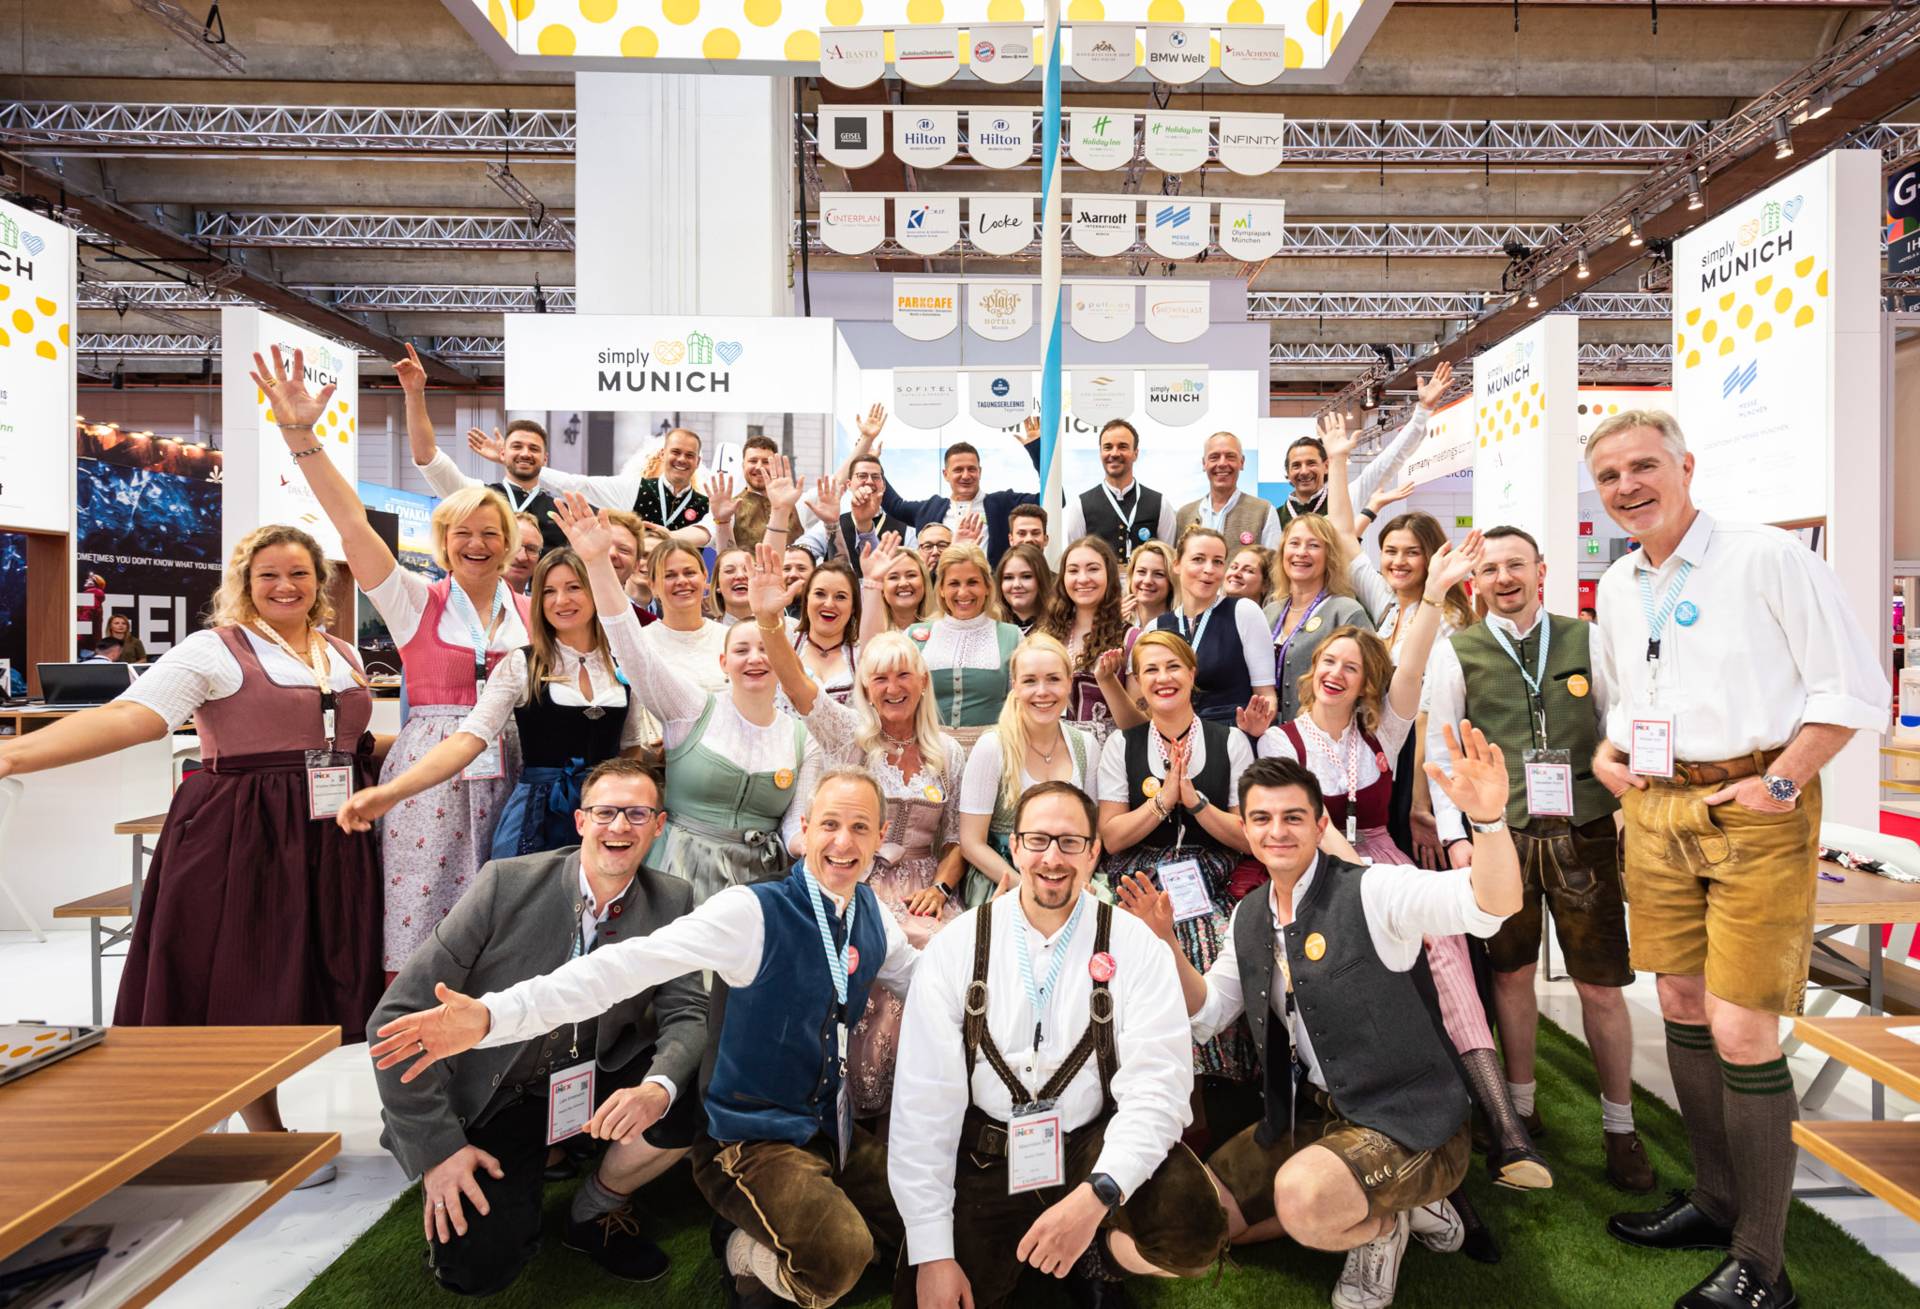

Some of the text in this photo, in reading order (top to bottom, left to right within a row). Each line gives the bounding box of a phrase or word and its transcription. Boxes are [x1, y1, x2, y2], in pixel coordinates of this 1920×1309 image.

[1150, 52, 1205, 63] BMW Welt
[840, 132, 861, 140] GEISEL
[1165, 126, 1191, 135] Holiday
[905, 133, 946, 145] Hilton
[980, 133, 1021, 145] Hilton
[1082, 138, 1108, 147] Holiday
[1223, 135, 1280, 145] INFINITY
[833, 215, 880, 223] INTERPLAN
[979, 213, 1023, 234] Locke
[1077, 211, 1127, 224] Marriott
[1701, 241, 1735, 268] simply
[1701, 230, 1793, 292] MUNICH
[898, 296, 953, 308] PARKCAFE
[598, 347, 650, 368] simply
[598, 371, 730, 393] MUNICH
[1487, 364, 1530, 397] MUNICH
[1150, 386, 1170, 394] simply
[1150, 394, 1200, 403] MUNICH
[77, 552, 114, 564] OMETIMES
[116, 556, 131, 564] YOU
[132, 557, 152, 566] DON'T
[153, 559, 174, 568] KNOW
[175, 561, 194, 569] WHAT
[195, 562, 207, 570] YOU
